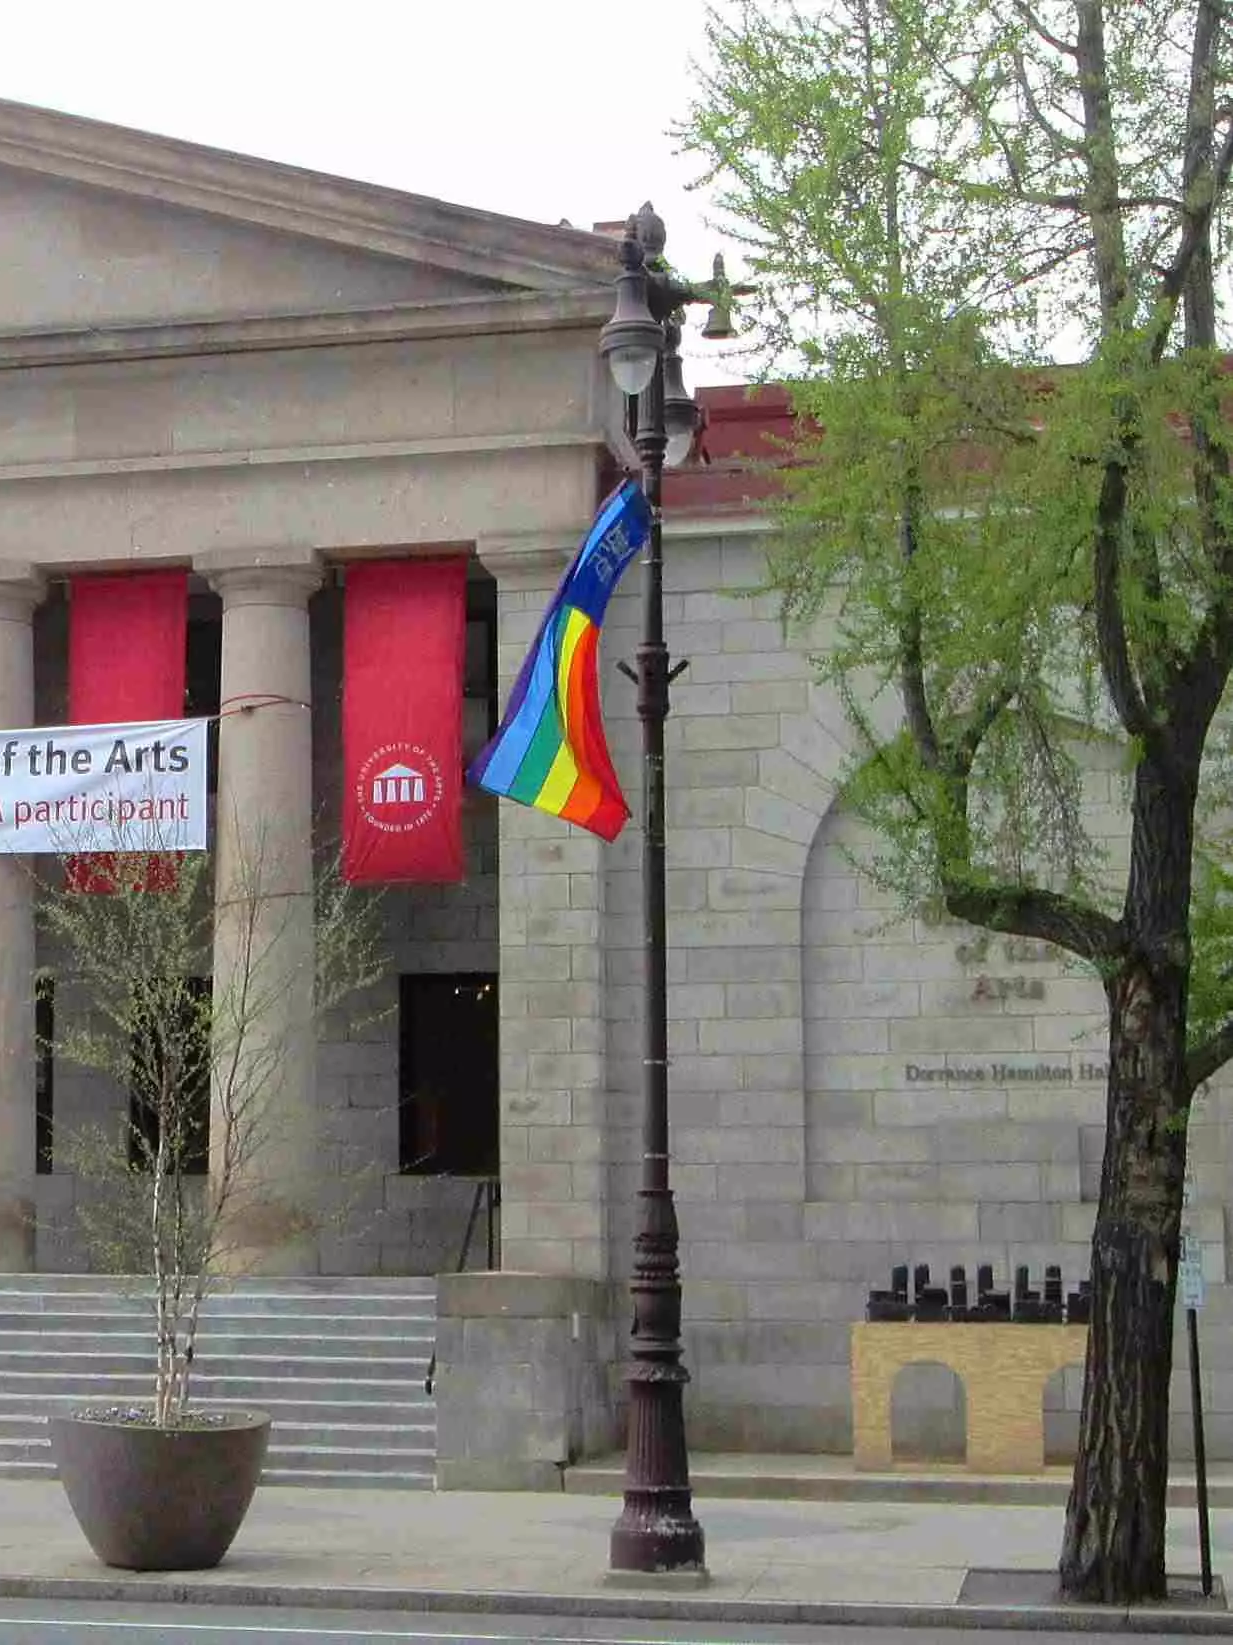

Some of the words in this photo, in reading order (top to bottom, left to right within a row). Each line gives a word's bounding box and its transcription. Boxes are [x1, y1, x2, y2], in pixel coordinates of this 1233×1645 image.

[28, 740, 92, 776] the
[105, 739, 189, 773] Arts
[15, 792, 189, 830] participant
[904, 1063, 986, 1081] Dorrance
[991, 1063, 1073, 1081] Hamilton
